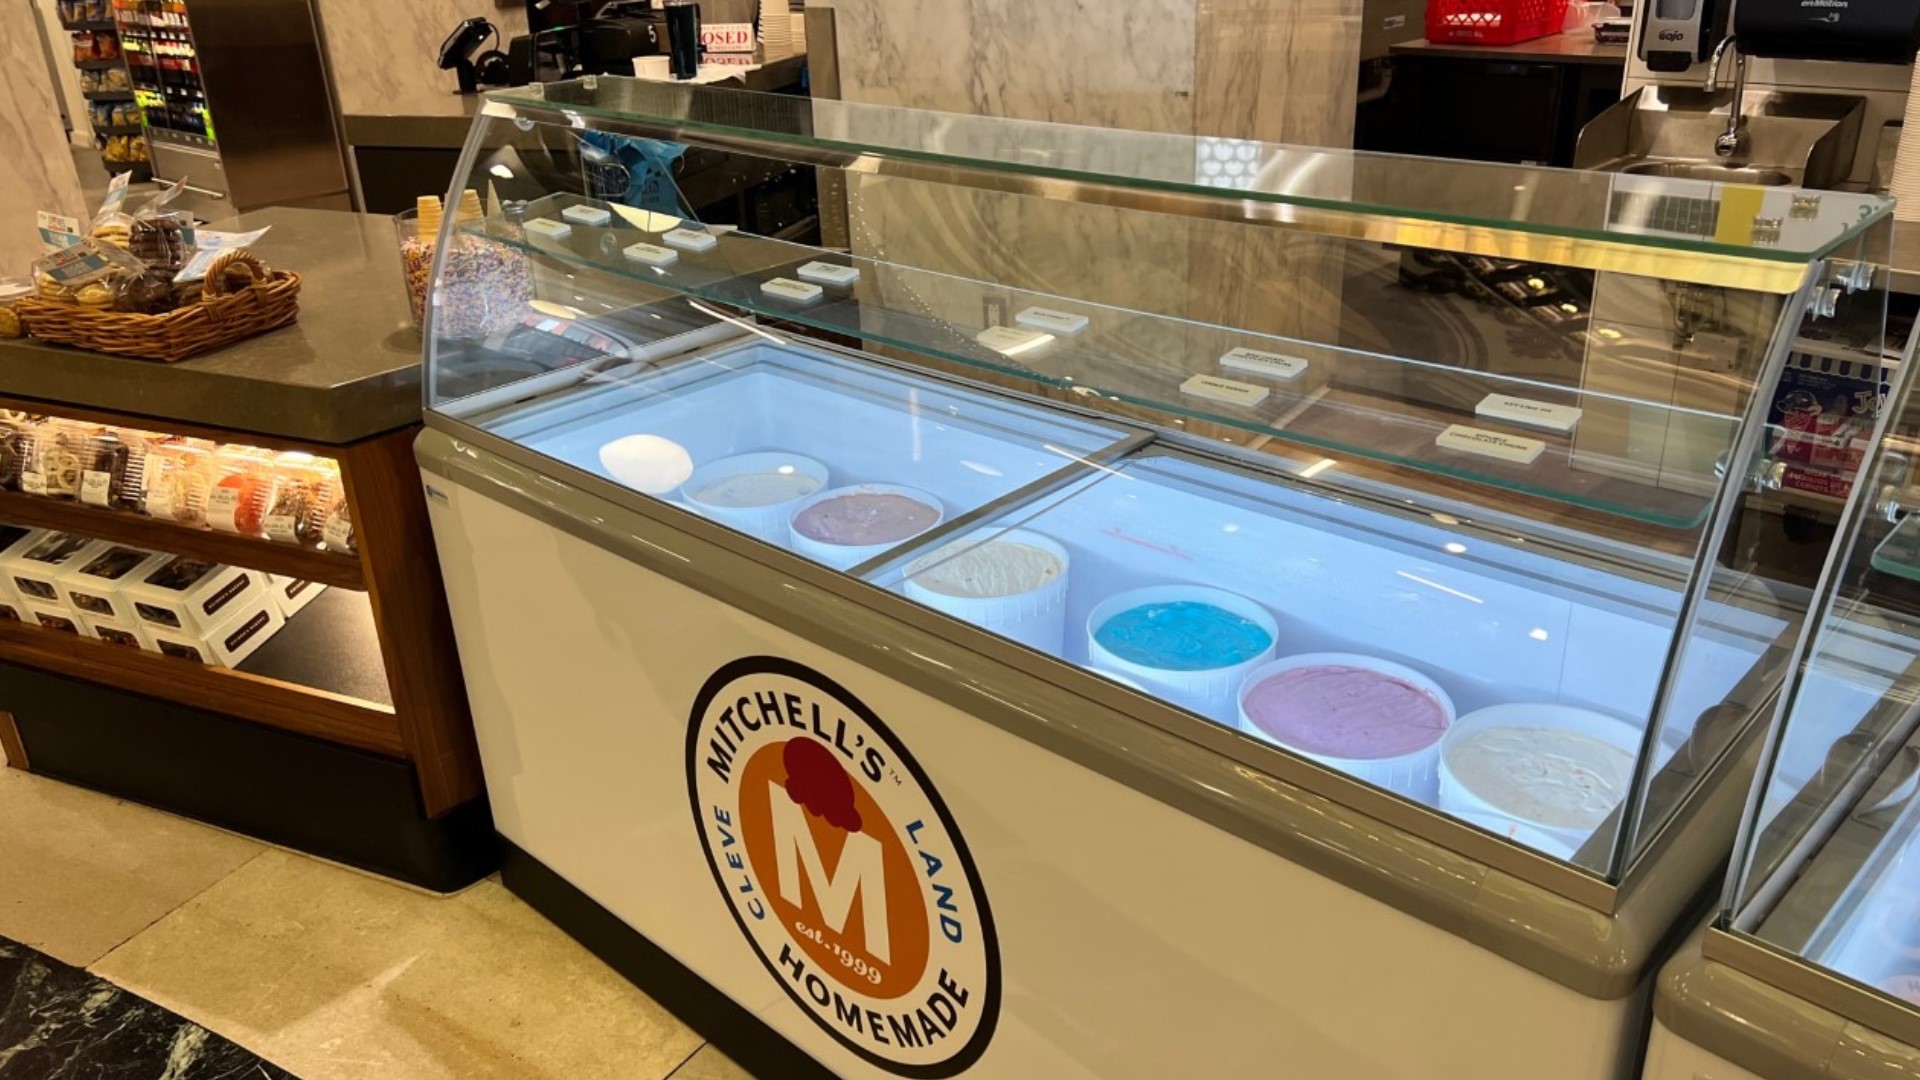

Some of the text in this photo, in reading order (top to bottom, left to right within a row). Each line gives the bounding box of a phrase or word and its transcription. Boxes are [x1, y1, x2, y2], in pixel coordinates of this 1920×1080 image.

[647, 24, 657, 43] 5
[702, 31, 748, 45] OSED
[706, 690, 886, 784] MITCHELL'S
[713, 805, 766, 921] CLEVE
[767, 778, 891, 967] M
[905, 819, 963, 944] LAND
[778, 943, 970, 1049] HOMEMADE
